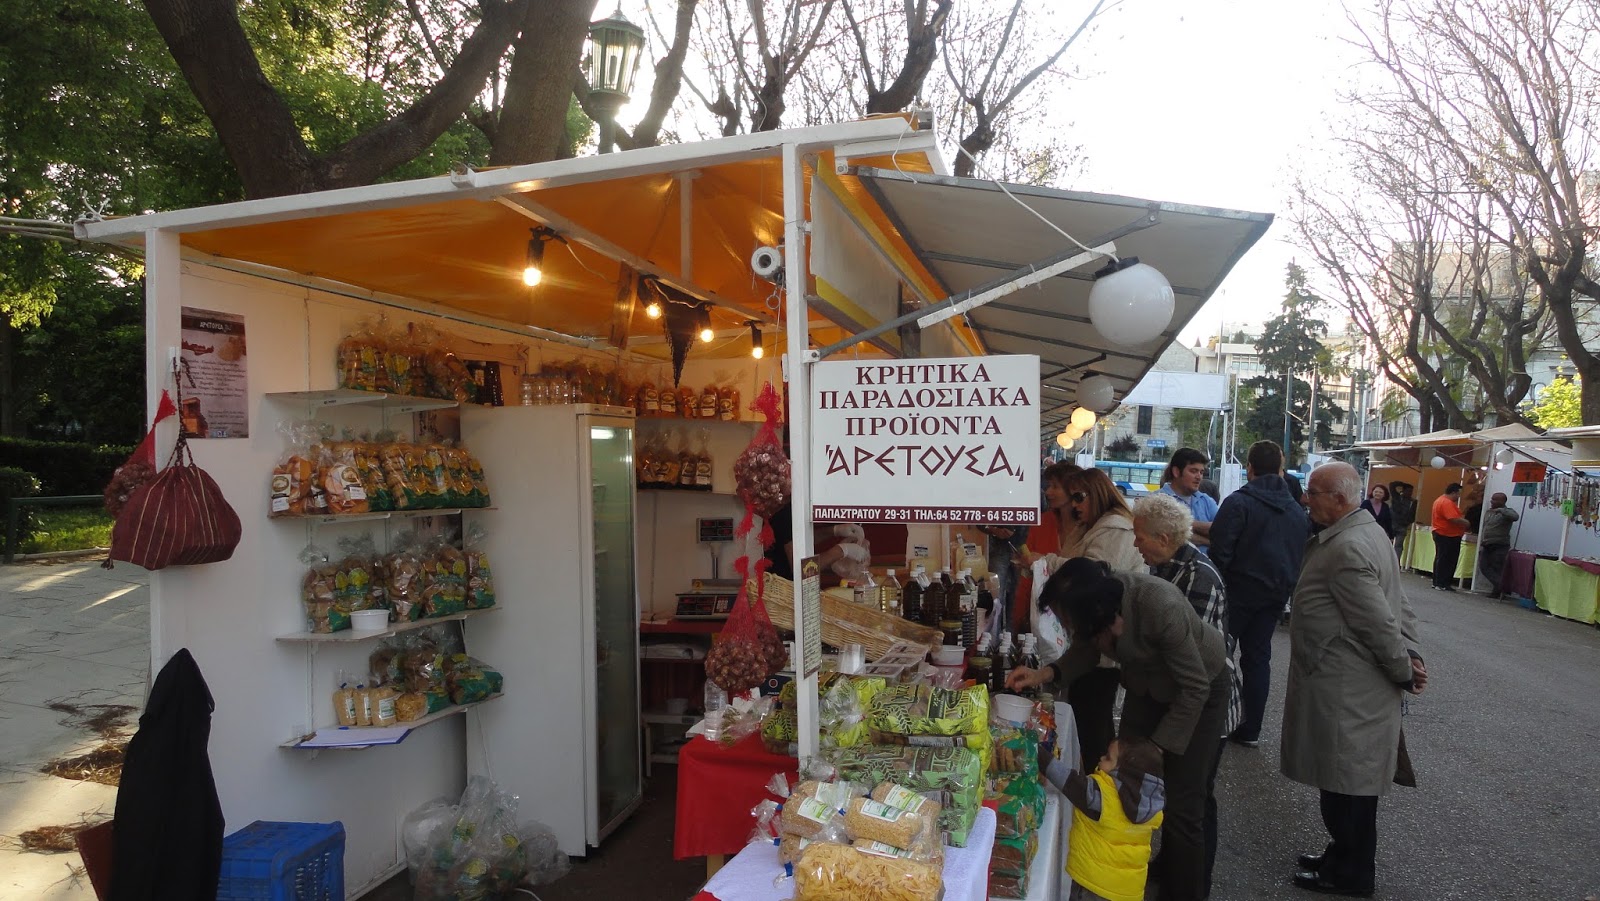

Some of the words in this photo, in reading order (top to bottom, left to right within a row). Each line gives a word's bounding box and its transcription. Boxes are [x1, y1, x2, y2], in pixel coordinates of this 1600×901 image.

[855, 363, 991, 385] ΚΡΗΤΙΚΑ
[819, 386, 1031, 409] ΠΑΡΑΔΟΣΙΑΚΑ
[845, 412, 1002, 436] ΠΡΟΪΟΝΤΑ
[814, 508, 881, 520] ΠΑΠΑΣΤΡΑΤΟΥ
[884, 509, 911, 520] 29-31
[950, 510, 962, 521] 52
[987, 510, 1000, 521] 64
[1002, 511, 1014, 522] 52
[1016, 511, 1035, 522] 568
